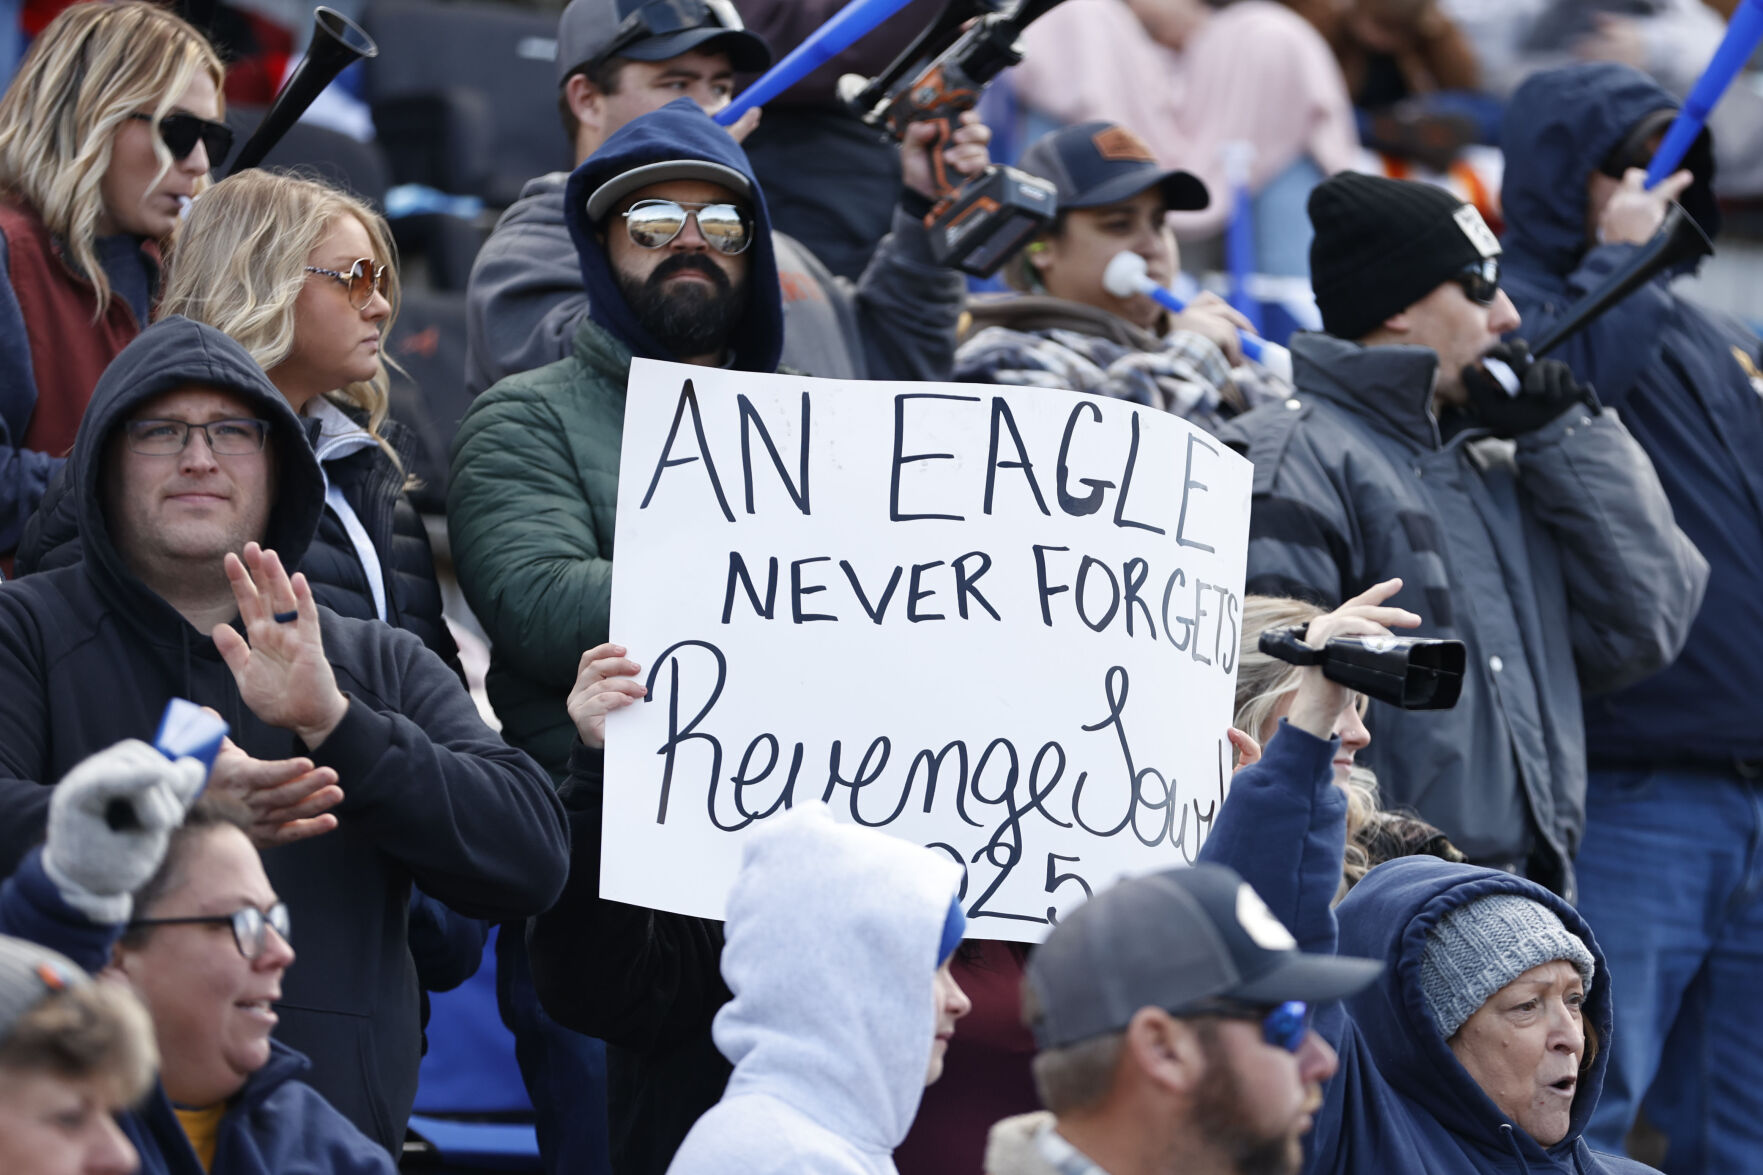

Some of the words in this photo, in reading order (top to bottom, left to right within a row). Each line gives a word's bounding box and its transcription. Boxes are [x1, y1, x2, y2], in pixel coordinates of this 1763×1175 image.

[640, 379, 811, 523] AN
[889, 394, 1219, 554] EAGLE
[721, 551, 1002, 626] NEVER
[1032, 544, 1239, 675] FORGETS
[643, 640, 1074, 868] Revenge
